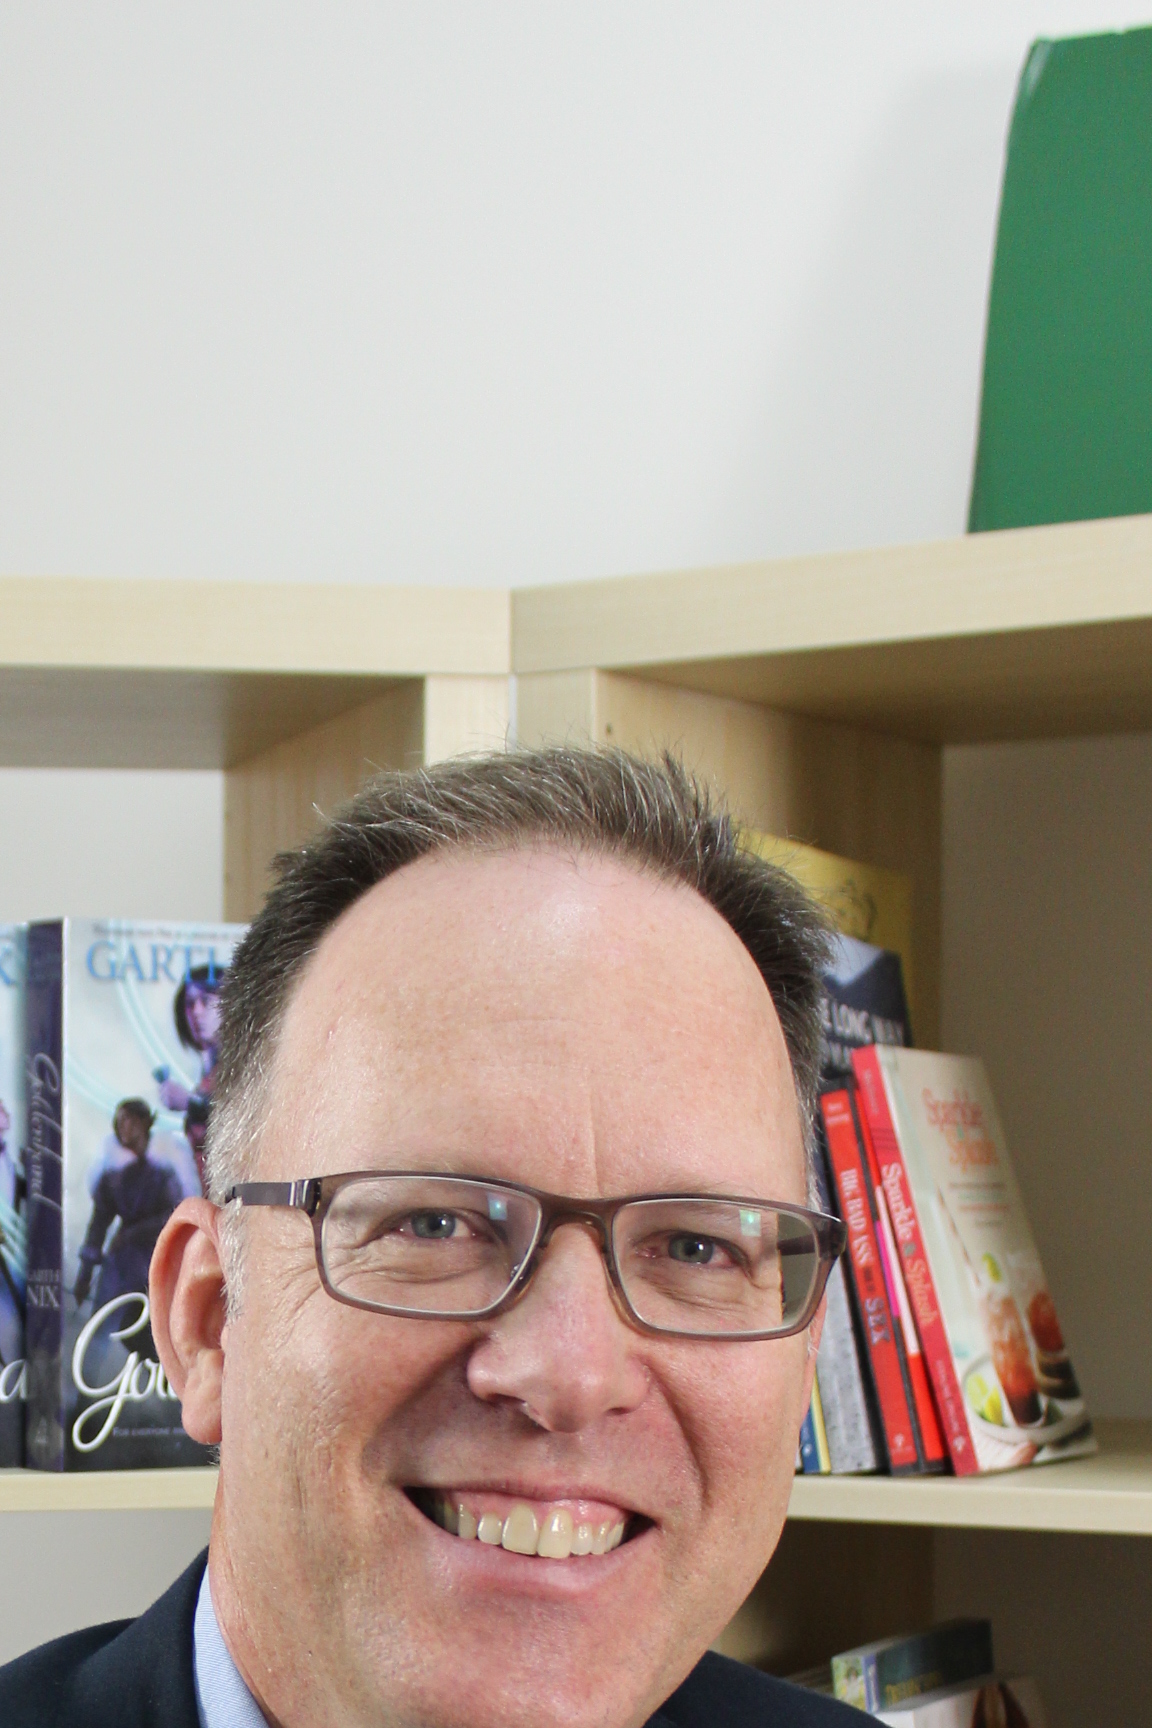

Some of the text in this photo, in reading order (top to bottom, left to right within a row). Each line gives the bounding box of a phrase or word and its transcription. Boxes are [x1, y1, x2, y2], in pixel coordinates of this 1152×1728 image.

[881, 1163, 915, 1241] Sparkle
[905, 1258, 936, 1327] Splash
[864, 1297, 891, 1346] SEX
